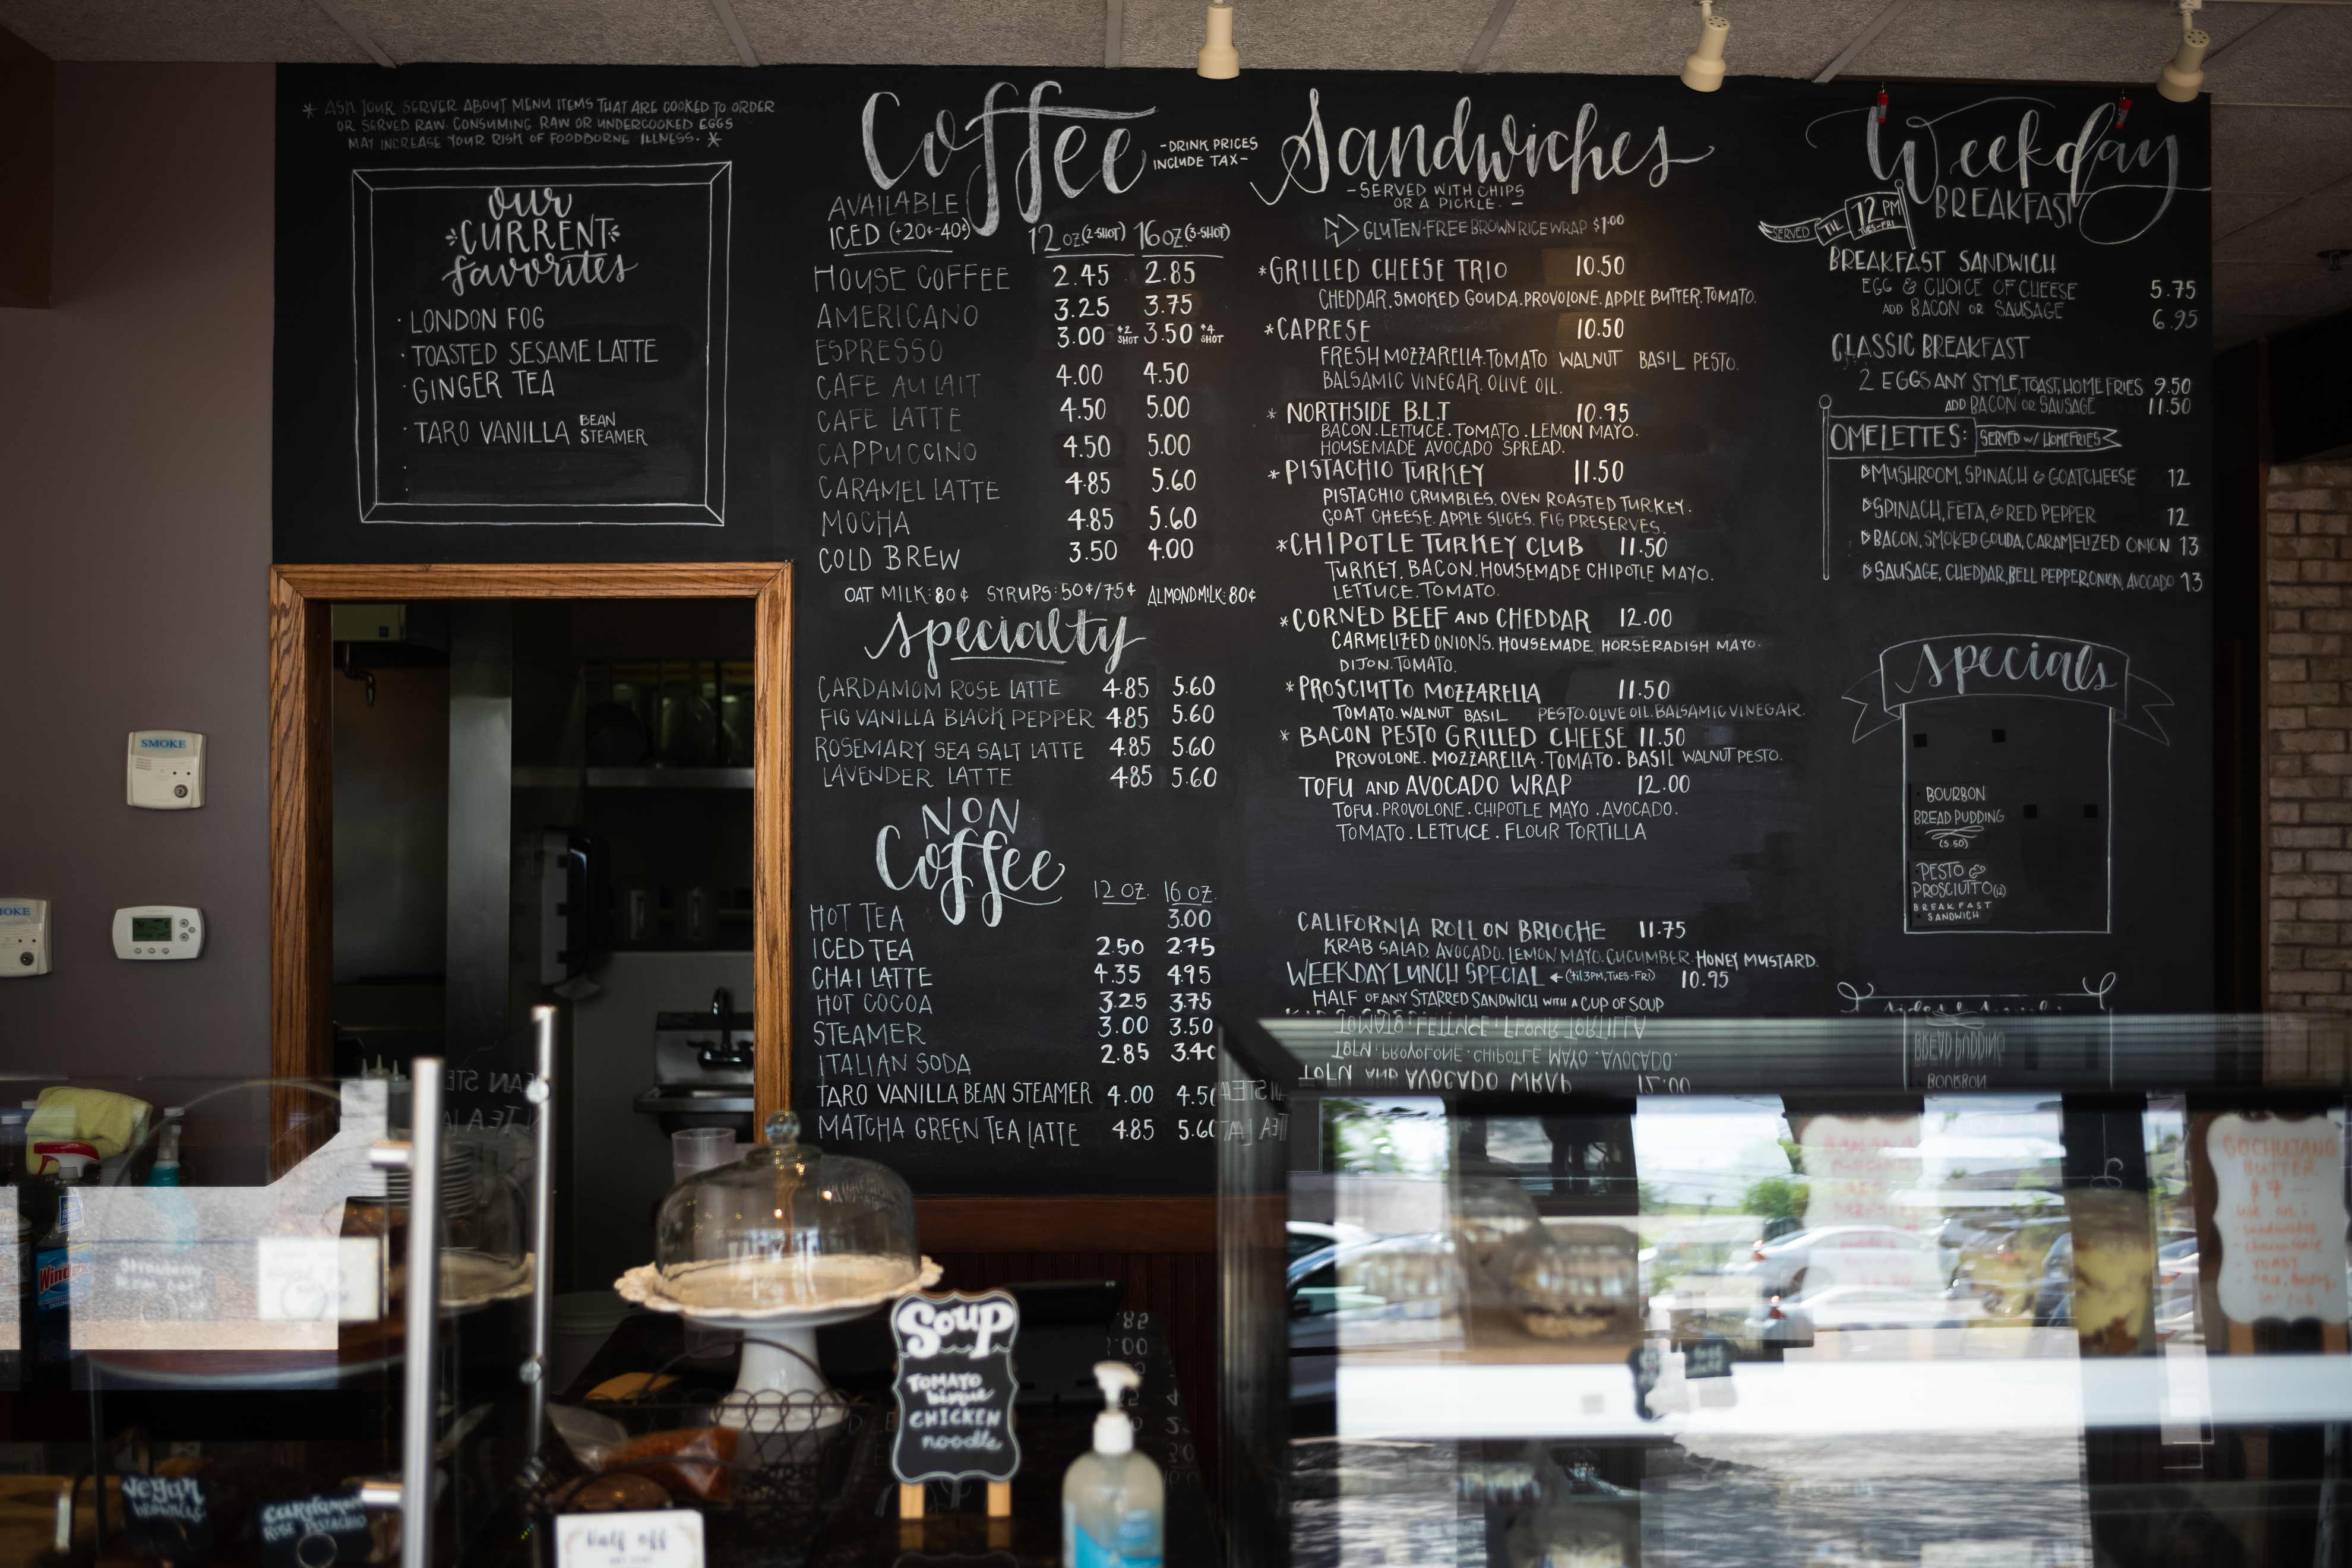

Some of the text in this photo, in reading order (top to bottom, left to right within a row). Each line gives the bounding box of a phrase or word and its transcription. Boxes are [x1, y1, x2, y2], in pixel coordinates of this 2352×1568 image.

[324, 97, 775, 119] ASK YOUR SERVER ABOUT MENU ITEMS THAT ARE COOKED TO ORDER
[337, 119, 356, 132] OR
[361, 118, 410, 132] SERVED
[453, 116, 532, 131] CONSUMING
[539, 115, 570, 129] RAW
[575, 116, 592, 129] OR
[597, 118, 694, 131] UNDERCOOKED
[698, 118, 734, 130] EGGS
[348, 137, 374, 150] MAY
[381, 135, 441, 150] INCREASE
[447, 134, 486, 148] YOUR
[491, 132, 523, 146] RISK
[529, 132, 545, 143] OF
[550, 132, 630, 145] FOODBORNE
[1213, 136, 1259, 151] PRICES
[1250, 88, 1715, 206] Sandwiches
[862, 81, 1159, 236] Coffee
[1153, 156, 1205, 170] INCLUDE
[1805, 97, 2211, 244] Weekday
[827, 190, 959, 222] AVAILABLE
[1772, 197, 1901, 239] SERVED TIL 12 PM
[1934, 186, 2093, 228] BREAKFAST
[460, 214, 614, 254] CURRENT
[830, 226, 880, 250] ICED
[1371, 257, 1444, 282] CHEESE
[1454, 258, 1507, 283] TRIO
[1576, 255, 1625, 277] 10.50
[1829, 245, 2056, 274] BREAKFAST SANDWICH
[814, 260, 1196, 294] HOUSE COFFEE 2.45 2.85
[1861, 277, 2196, 301] EGG & CHOICE OF CHEESE 5.75
[410, 306, 545, 334] LONDON FOG
[817, 293, 1193, 330] AMERICANO 3.25 3.75
[1882, 297, 2198, 331] ADD BACON OR SAUSAGE 6.95
[1577, 317, 1624, 340] 10.50
[411, 339, 659, 367] TOASTED SESAME LATTE
[815, 322, 1193, 366] ESPRESSO 3.00 3.50
[413, 369, 555, 404] GINGER TEA
[1323, 370, 1404, 391] BALSAMIC
[1487, 374, 1528, 394] OLIVE
[579, 412, 616, 428] BEAN
[1286, 400, 1629, 424] NORTHSIDE B.L.T 10.95
[413, 420, 570, 447] TARO VANILLA
[580, 428, 649, 446] STEAMER
[1980, 429, 2021, 447] SERVED
[2043, 429, 2101, 448] HOMEFRIES
[1321, 439, 1417, 456] HOUSEMADE
[1424, 440, 1493, 457] AVOCADO
[821, 505, 1197, 538] MOCHA 4.85 5.60
[818, 538, 1194, 574] COLD BREW 3.50 4.00
[818, 675, 1215, 703] CARDAMOM ROSE LATTE 4.85 5.60
[141, 739, 186, 749] SMOKE
[823, 764, 1218, 789] LAVENDER LATTE 4.85 5.60
[1298, 776, 1353, 799] TOFU
[1405, 774, 1499, 796] AVOCADO
[1510, 773, 1572, 797] WRAP
[1638, 774, 1690, 795] 12.00
[1926, 785, 1985, 802] BOURBON
[923, 796, 1019, 839] NON
[1914, 809, 2005, 826] BREAD PUDDING
[1939, 838, 1968, 849] (5.50)
[875, 825, 1066, 927] Coffee
[1914, 901, 1992, 911] BREAKFAST
[1928, 911, 1979, 921] SANDWICH
[1297, 911, 1686, 943] CALIFORNIA ROLL ON BRIOCHE 11.75
[819, 1042, 1149, 1077] ITALIAN SODA 2.85
[62, 1215, 80, 1224] PLASTIC
[39, 1263, 91, 1295] Windex
[49, 1298, 72, 1309] ORIGINAL
[896, 1301, 1016, 1359] Soup
[906, 1371, 983, 1393] TOMATO
[926, 1387, 996, 1406] bisque
[909, 1407, 1002, 1427] CHICKEN
[922, 1428, 1004, 1450] noodle
